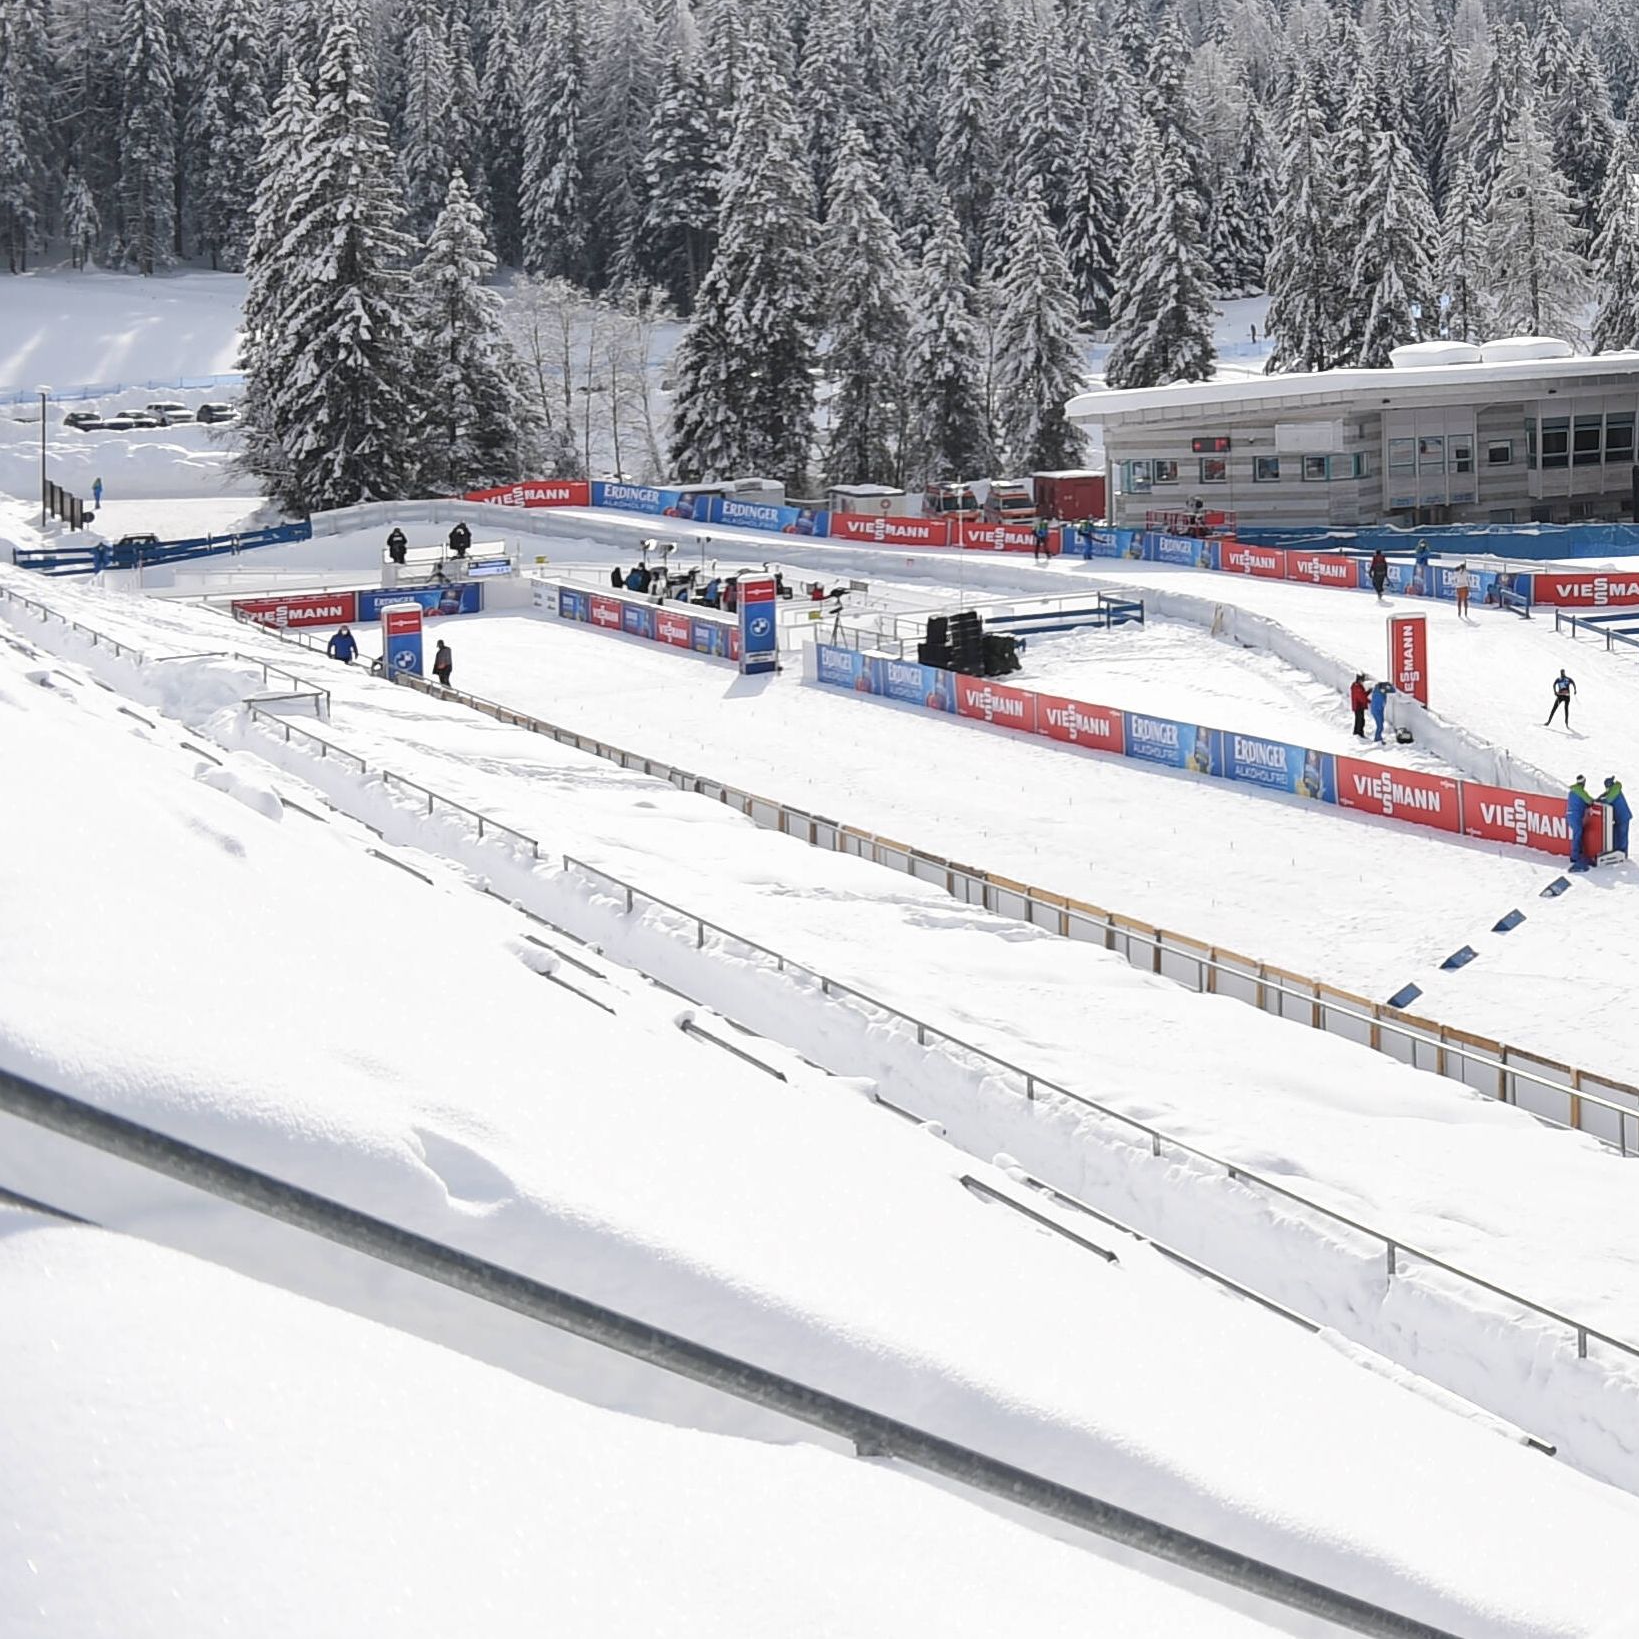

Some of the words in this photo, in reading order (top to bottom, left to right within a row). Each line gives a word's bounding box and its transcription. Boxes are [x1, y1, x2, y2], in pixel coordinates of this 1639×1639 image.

[603, 484, 659, 505] ERDINGER
[722, 501, 779, 523] ERDINGER
[847, 518, 930, 542] VIESSMANN
[966, 686, 1024, 721] VIESSMANN
[1047, 703, 1110, 740] VIESSMANN
[1131, 715, 1180, 747] ERDINGER
[1234, 736, 1288, 773] ERDINGER
[1353, 771, 1441, 815] VIESSMANN
